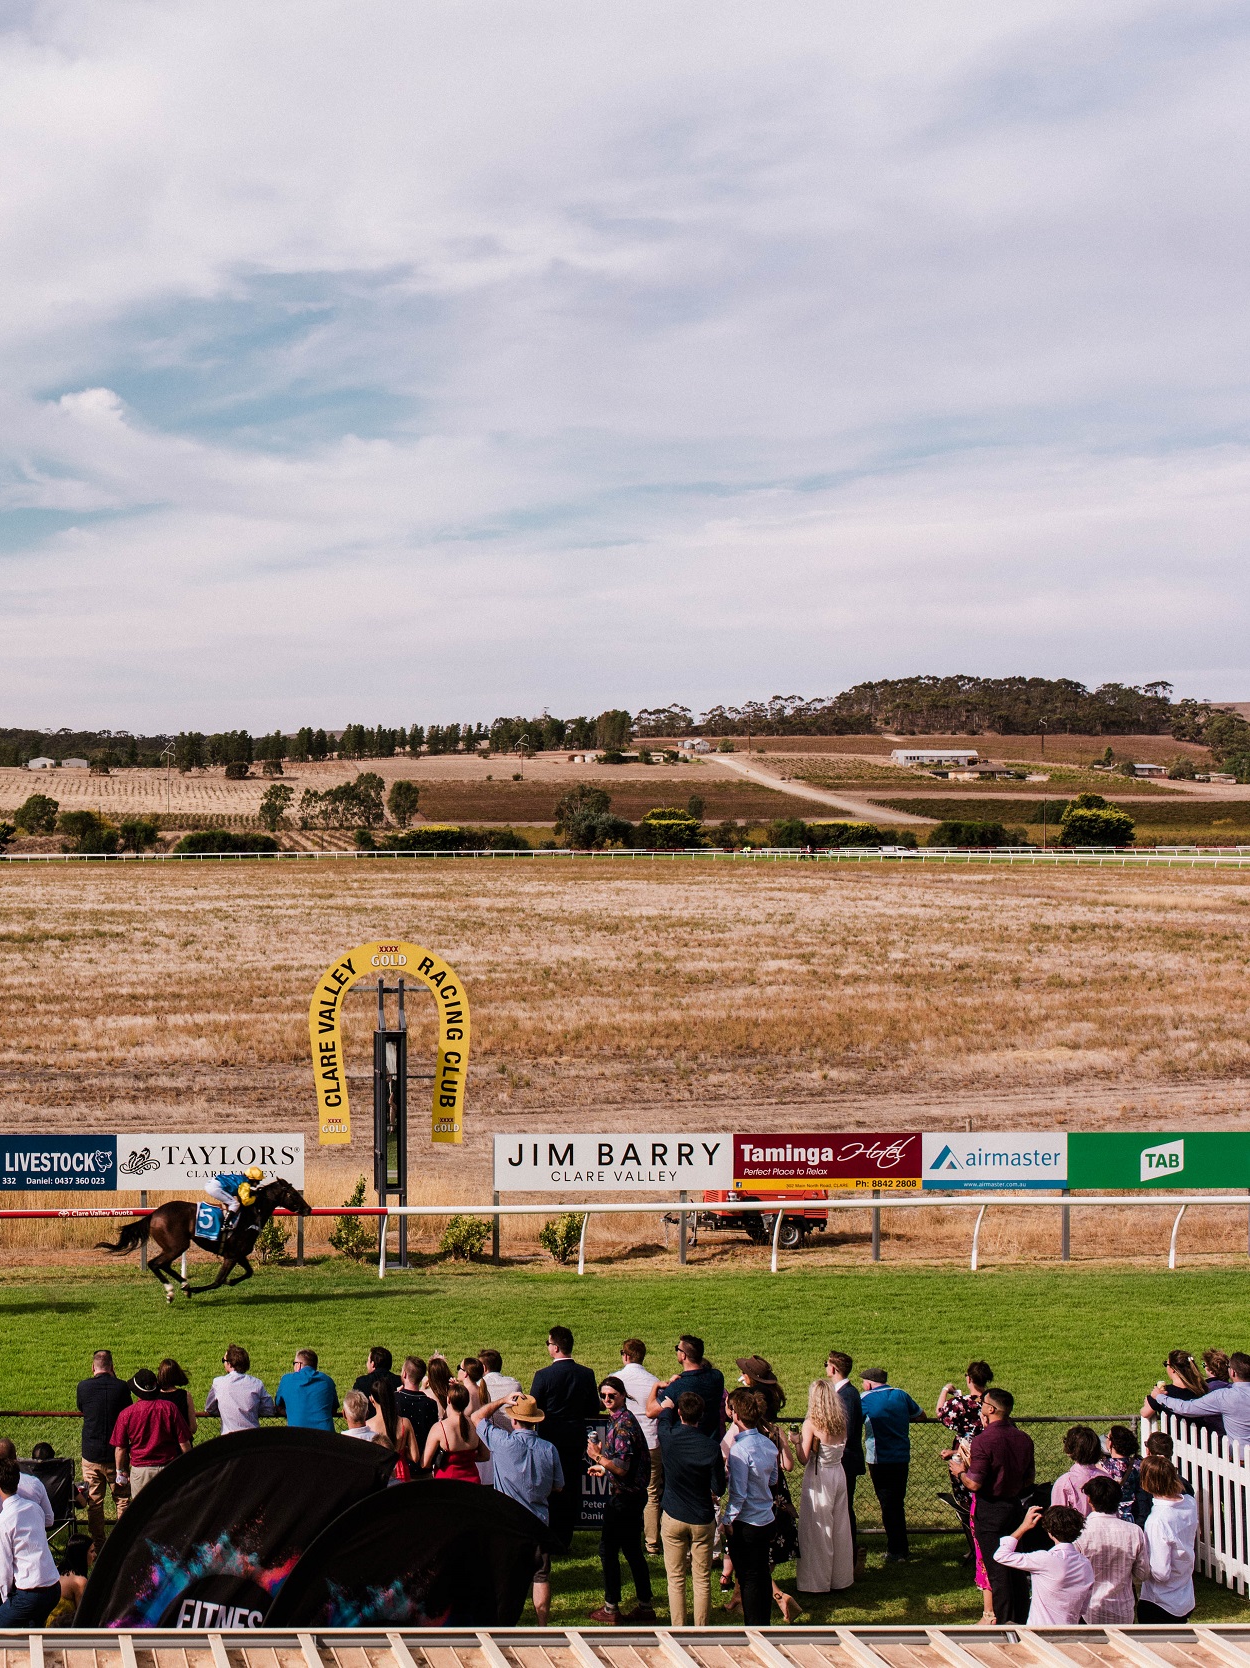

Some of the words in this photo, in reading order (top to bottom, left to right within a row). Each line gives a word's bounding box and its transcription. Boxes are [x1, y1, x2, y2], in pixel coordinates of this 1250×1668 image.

[370, 954, 407, 966] GOLD
[318, 958, 356, 1034] VALLEY
[417, 956, 464, 1040] RACING
[318, 1040, 342, 1108] CLARE
[440, 1052, 462, 1108] CLUB
[322, 1125, 348, 1133] GOLD
[434, 1124, 460, 1132] GOLD
[6, 1152, 96, 1172] LIVESTOCK
[162, 1146, 294, 1165] TAYLORS
[508, 1143, 574, 1166] JIM
[598, 1142, 721, 1166] BARRY
[740, 1144, 833, 1165] Taminga
[837, 1136, 916, 1169] Hotel
[966, 1148, 1061, 1167] airmaster
[1145, 1154, 1180, 1168] TAB
[551, 1171, 605, 1182] CLARE
[614, 1171, 678, 1182] VALLEY
[744, 1168, 771, 1176] Perfect
[198, 1208, 213, 1229] 5
[176, 1599, 263, 1628] FITNES
